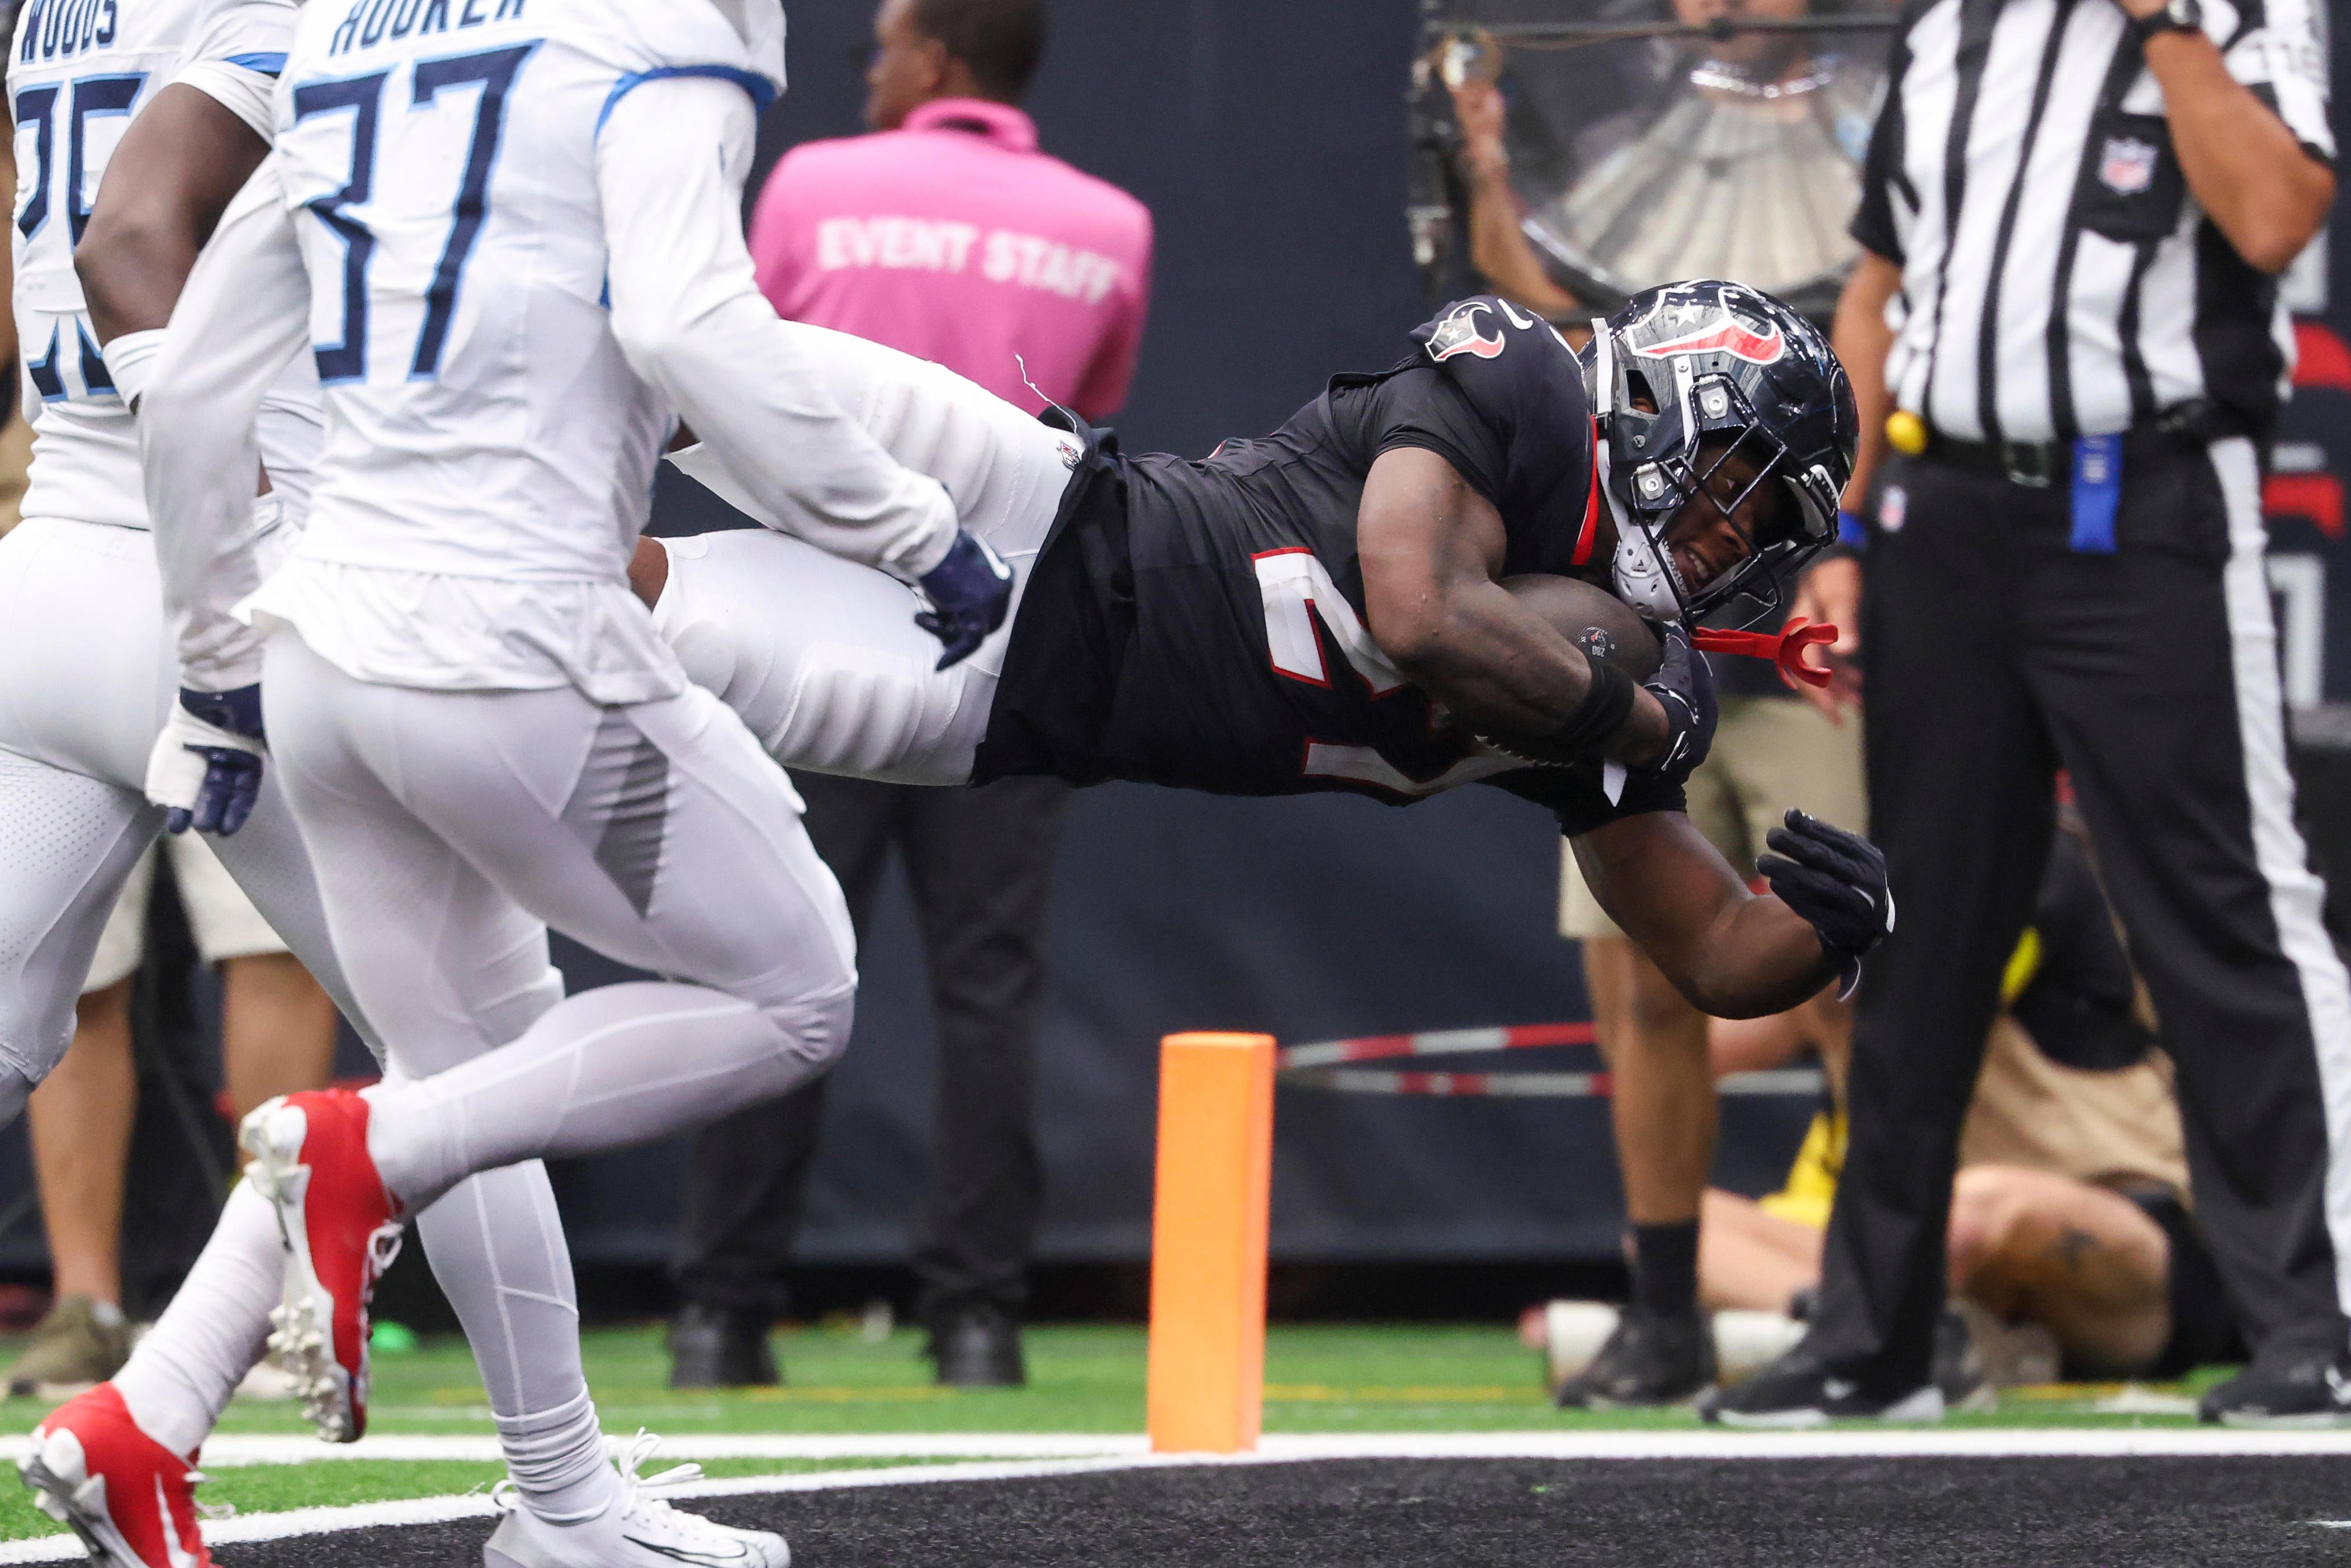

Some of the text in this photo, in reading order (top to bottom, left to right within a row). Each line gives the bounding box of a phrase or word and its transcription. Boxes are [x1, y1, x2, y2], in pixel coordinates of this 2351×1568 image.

[328, 0, 526, 59] HOOK
[292, 39, 547, 387] 37
[818, 216, 1118, 304] EVENT STAFF
